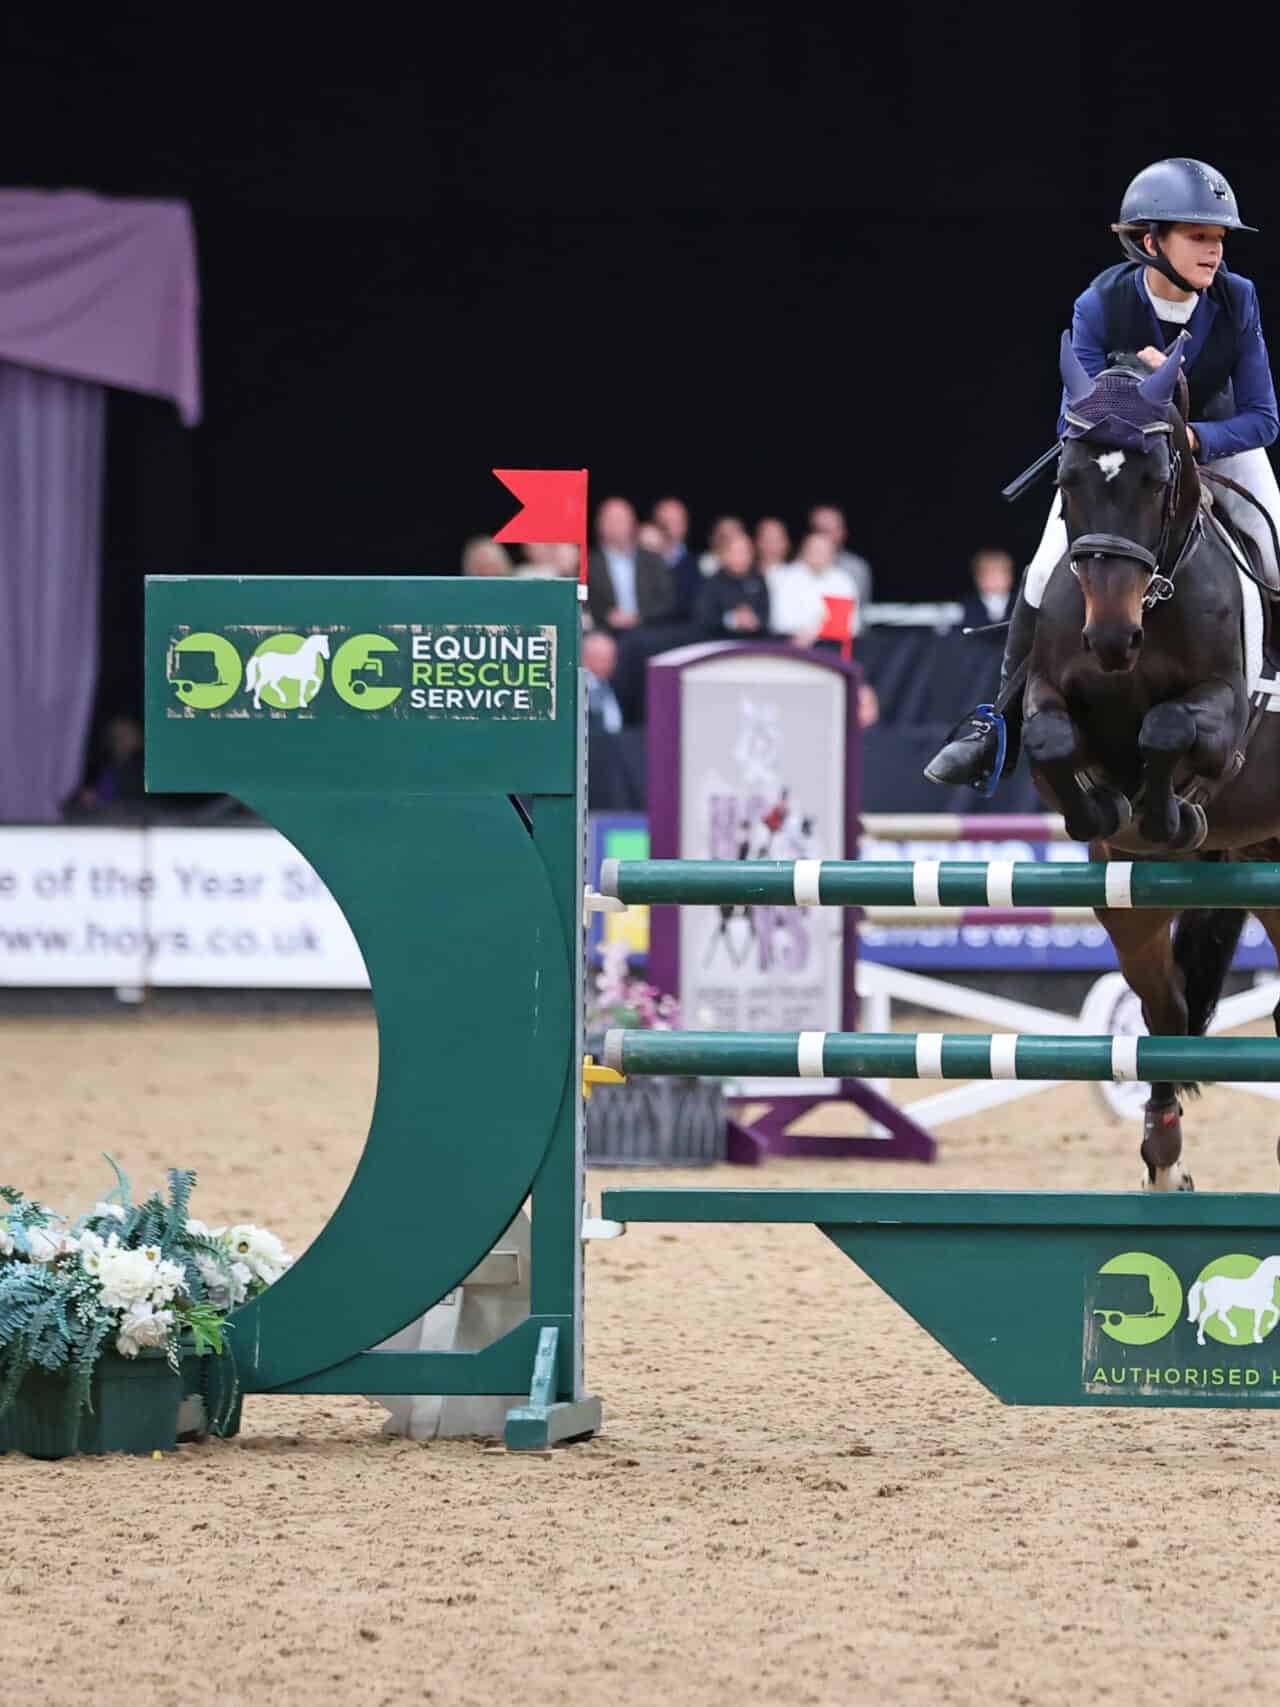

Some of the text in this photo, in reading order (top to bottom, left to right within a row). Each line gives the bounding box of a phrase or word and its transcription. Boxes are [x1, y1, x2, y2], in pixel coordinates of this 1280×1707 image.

[411, 635, 548, 660] EQUINE
[411, 662, 548, 686] RESCUE
[33, 866, 75, 895] of
[89, 866, 154, 895] the
[173, 866, 264, 895] Year
[1092, 1367, 1261, 1386] AUTHORISED
